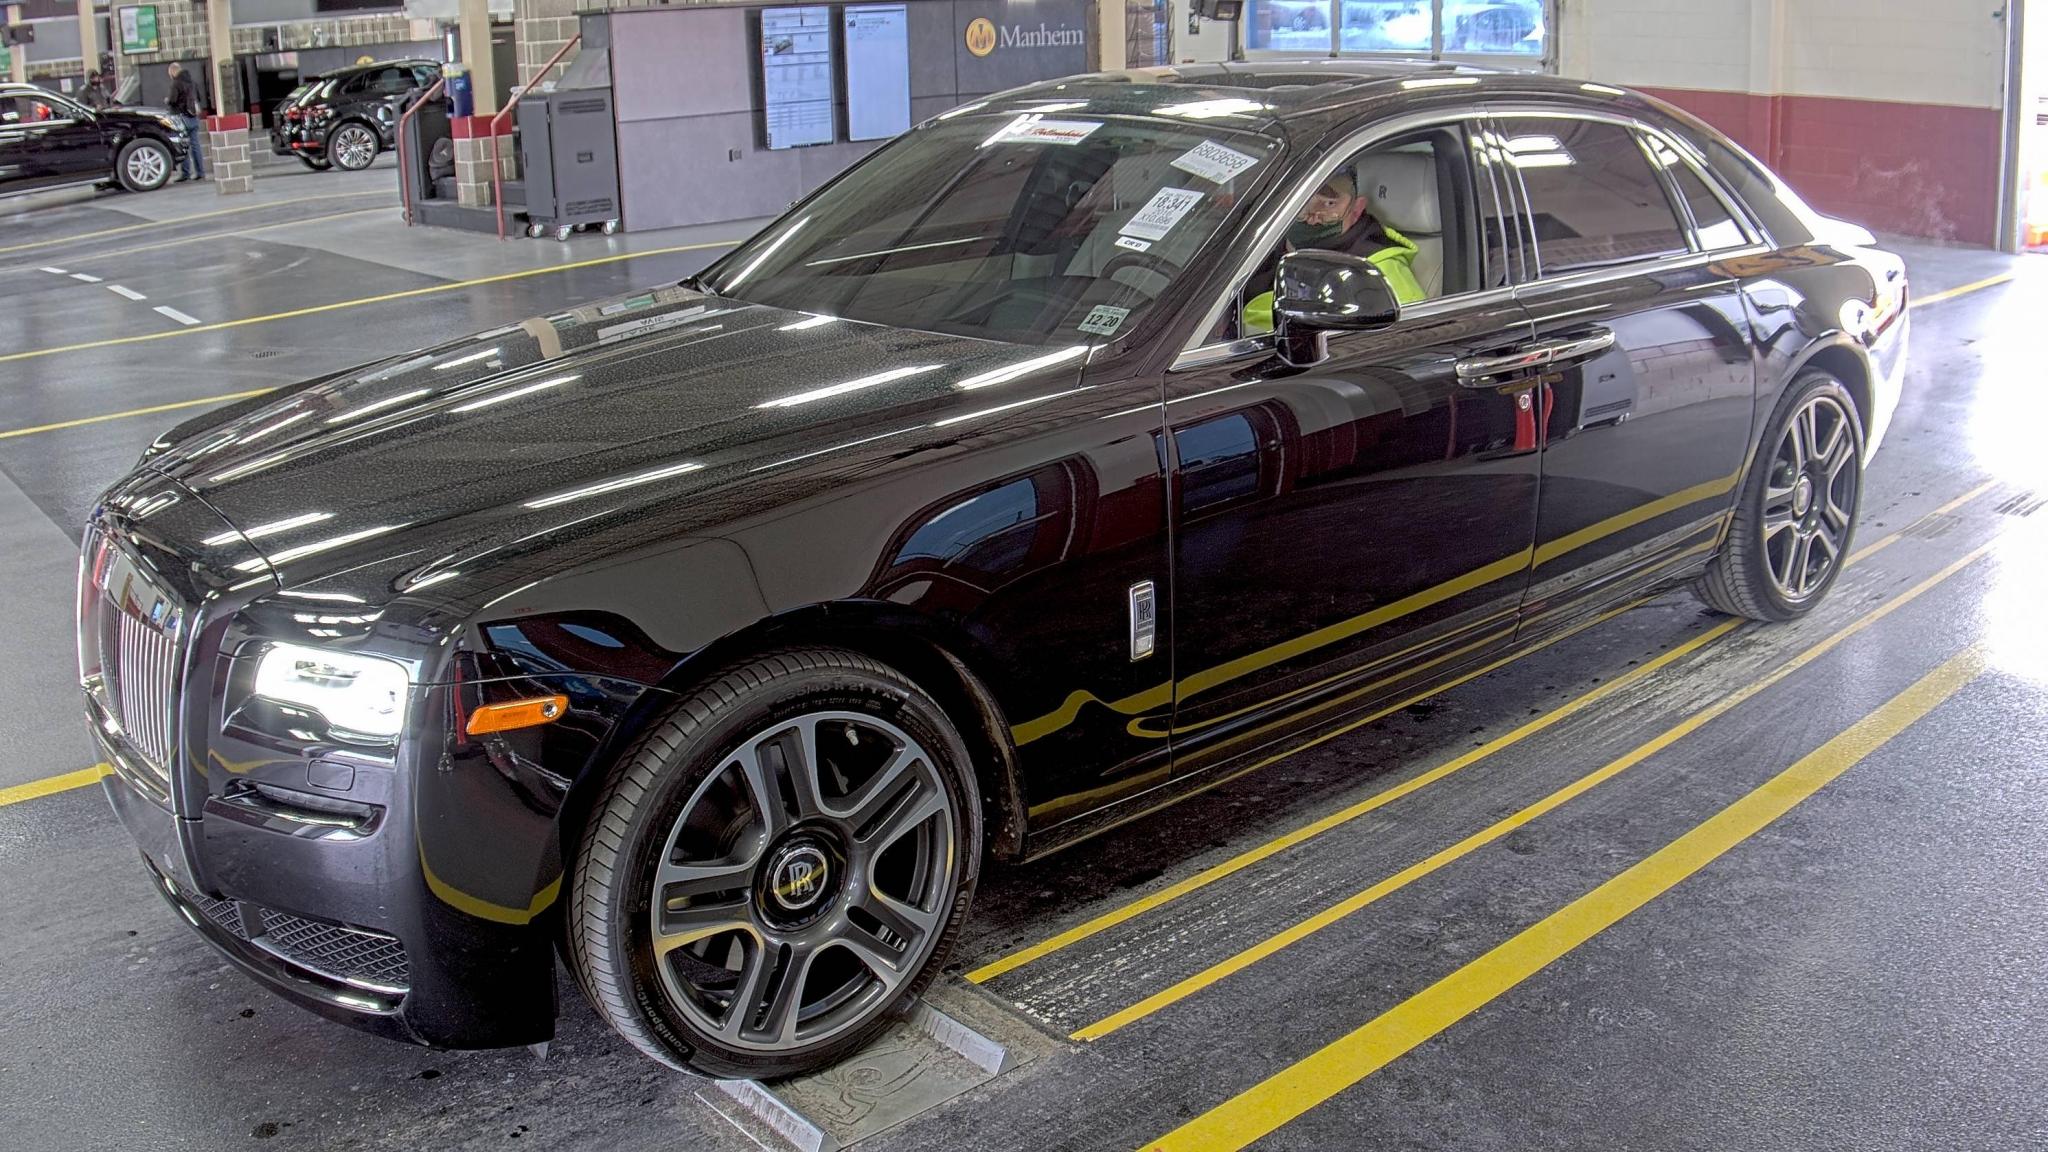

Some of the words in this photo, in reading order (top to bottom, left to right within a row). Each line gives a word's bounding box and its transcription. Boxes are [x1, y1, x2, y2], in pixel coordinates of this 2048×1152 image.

[1000, 23, 1084, 49] Manheim
[1192, 144, 1249, 169] 6803658
[1152, 195, 1191, 211] 18:341
[1085, 314, 1103, 326] 12
[1101, 316, 1119, 328] 20
